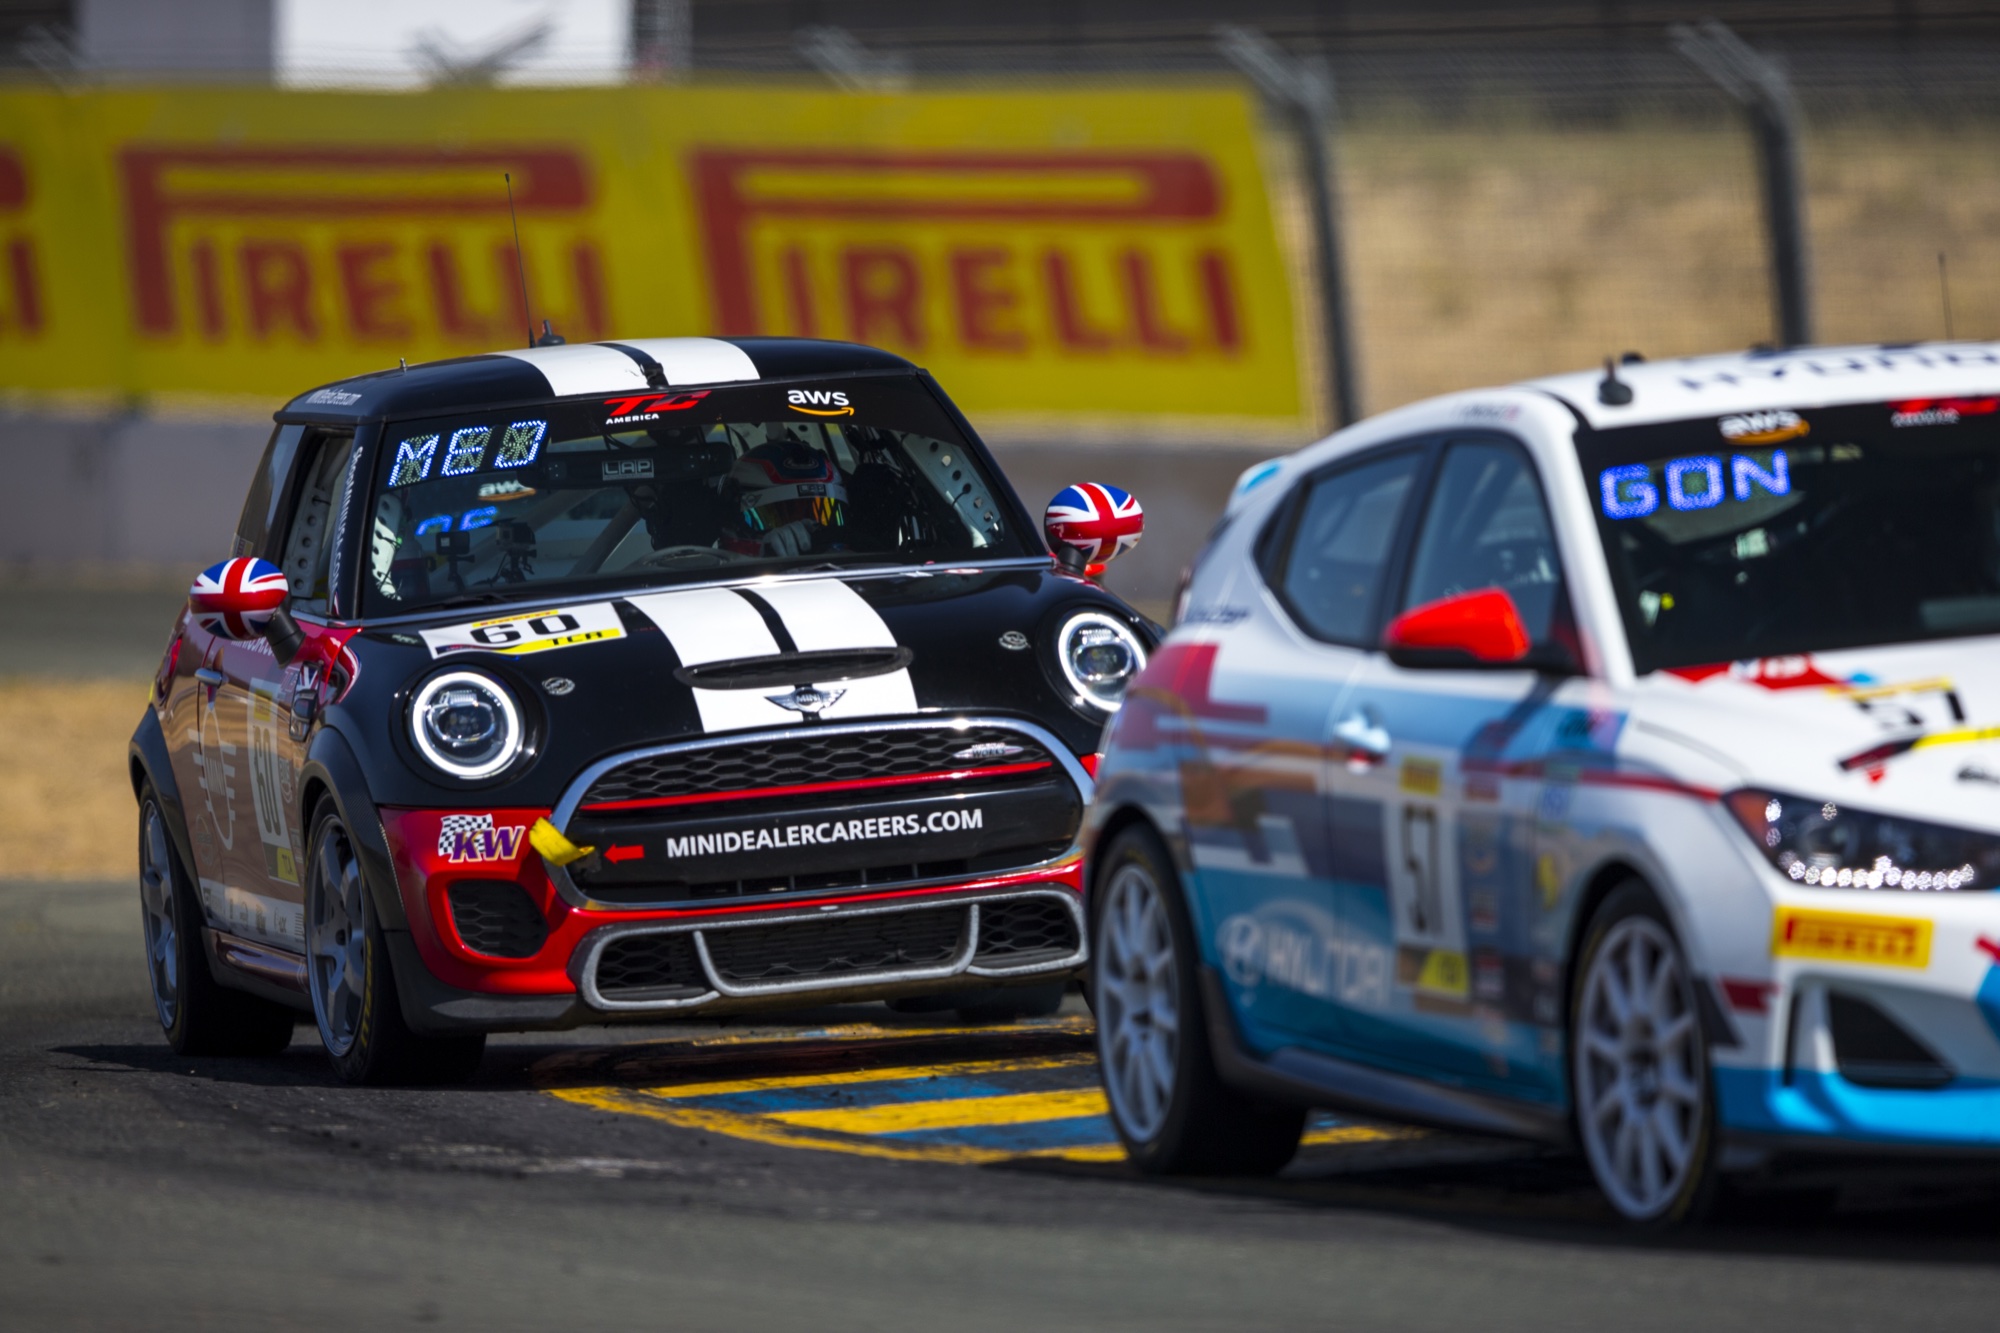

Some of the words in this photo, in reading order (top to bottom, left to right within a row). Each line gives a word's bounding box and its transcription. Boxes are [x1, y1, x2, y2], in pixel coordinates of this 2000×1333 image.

[118, 146, 612, 345] PIRELLI
[686, 150, 1243, 358] PIRELLI
[787, 388, 850, 407] aws
[605, 412, 660, 425] AMERICA
[604, 460, 651, 475] LAP
[479, 480, 524, 496] aw
[1600, 449, 1791, 520] GON
[469, 614, 581, 644] 60
[546, 631, 604, 646] TCA
[448, 825, 526, 863] KW
[667, 808, 983, 858] MINIDEALERCAREERS.COM
